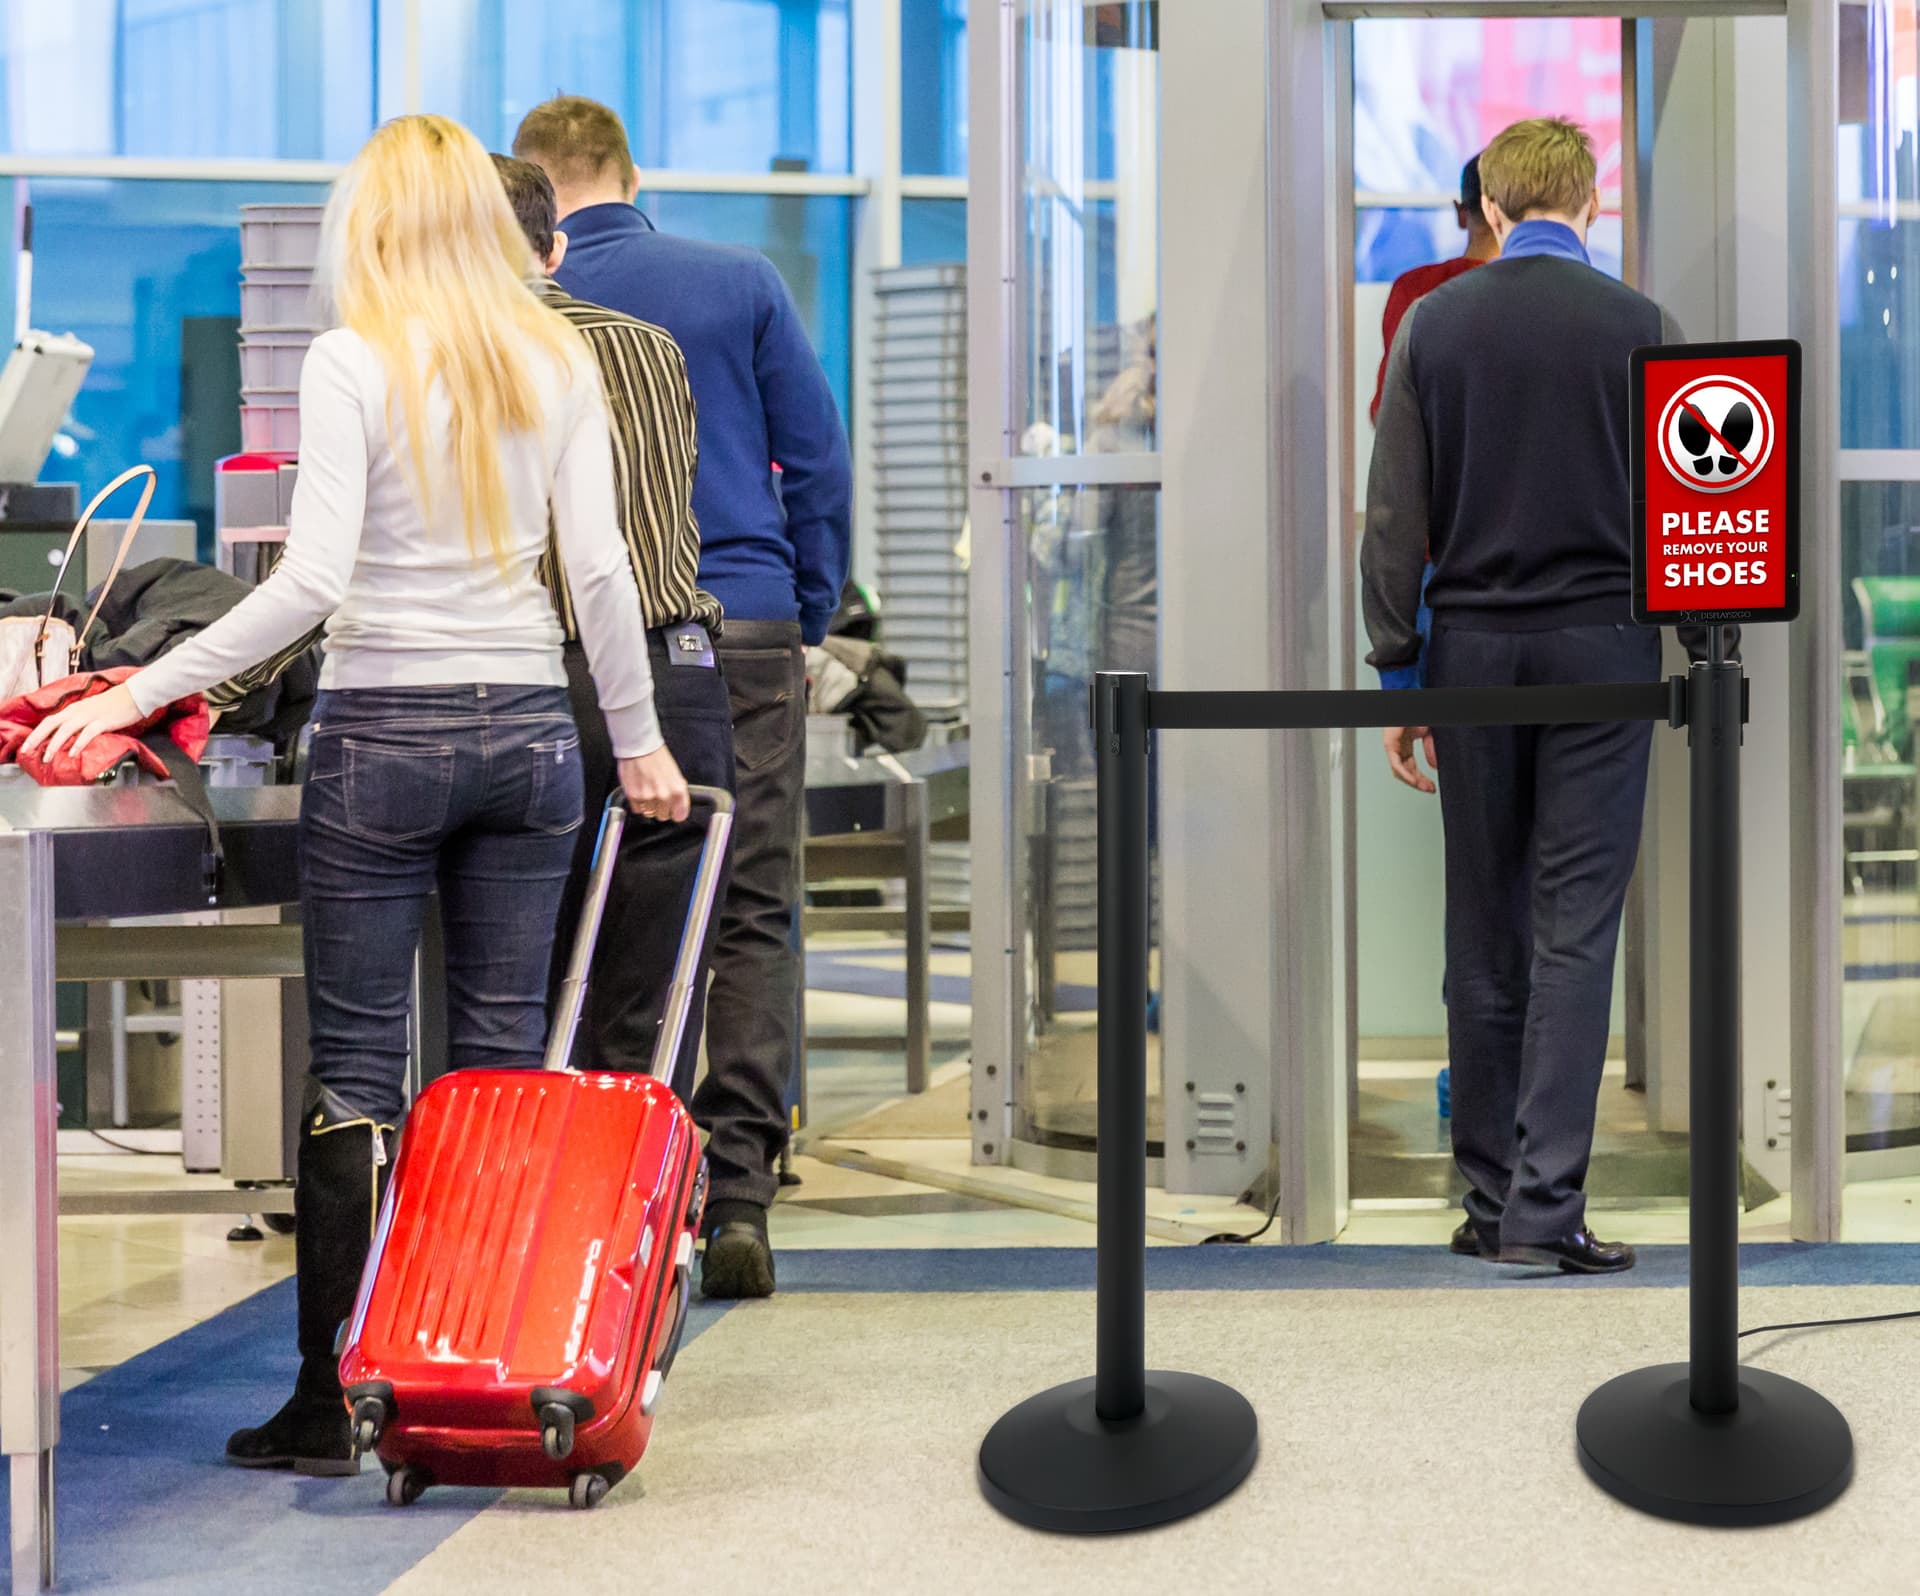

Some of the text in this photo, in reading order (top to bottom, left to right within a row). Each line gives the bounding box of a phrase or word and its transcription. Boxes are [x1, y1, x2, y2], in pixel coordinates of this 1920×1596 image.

[1662, 509, 1769, 536] PLEASE
[1663, 541, 1768, 556] REMOVE YOUR
[1664, 560, 1767, 587] SHOES
